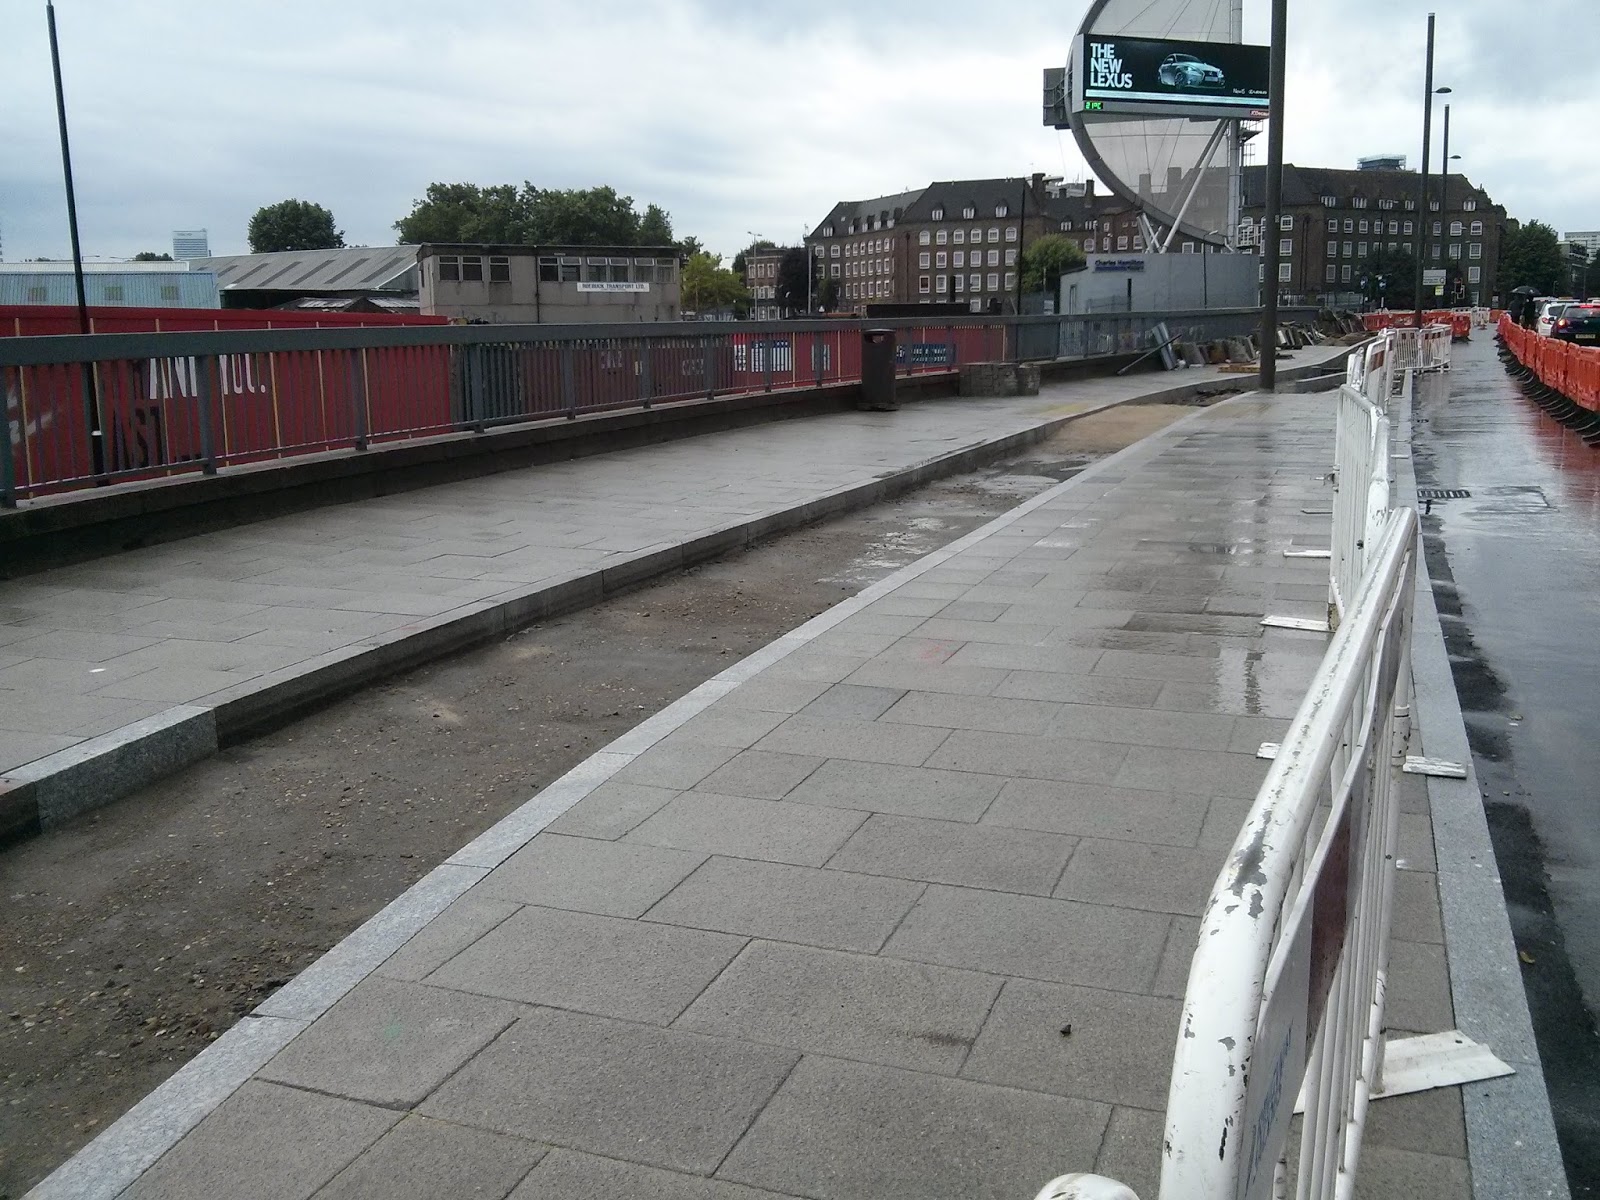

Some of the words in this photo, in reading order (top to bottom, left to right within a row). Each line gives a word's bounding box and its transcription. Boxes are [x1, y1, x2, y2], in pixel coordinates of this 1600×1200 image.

[1090, 42, 1115, 59] THE
[1090, 57, 1123, 74] NEW
[1090, 71, 1133, 89] LEXUS
